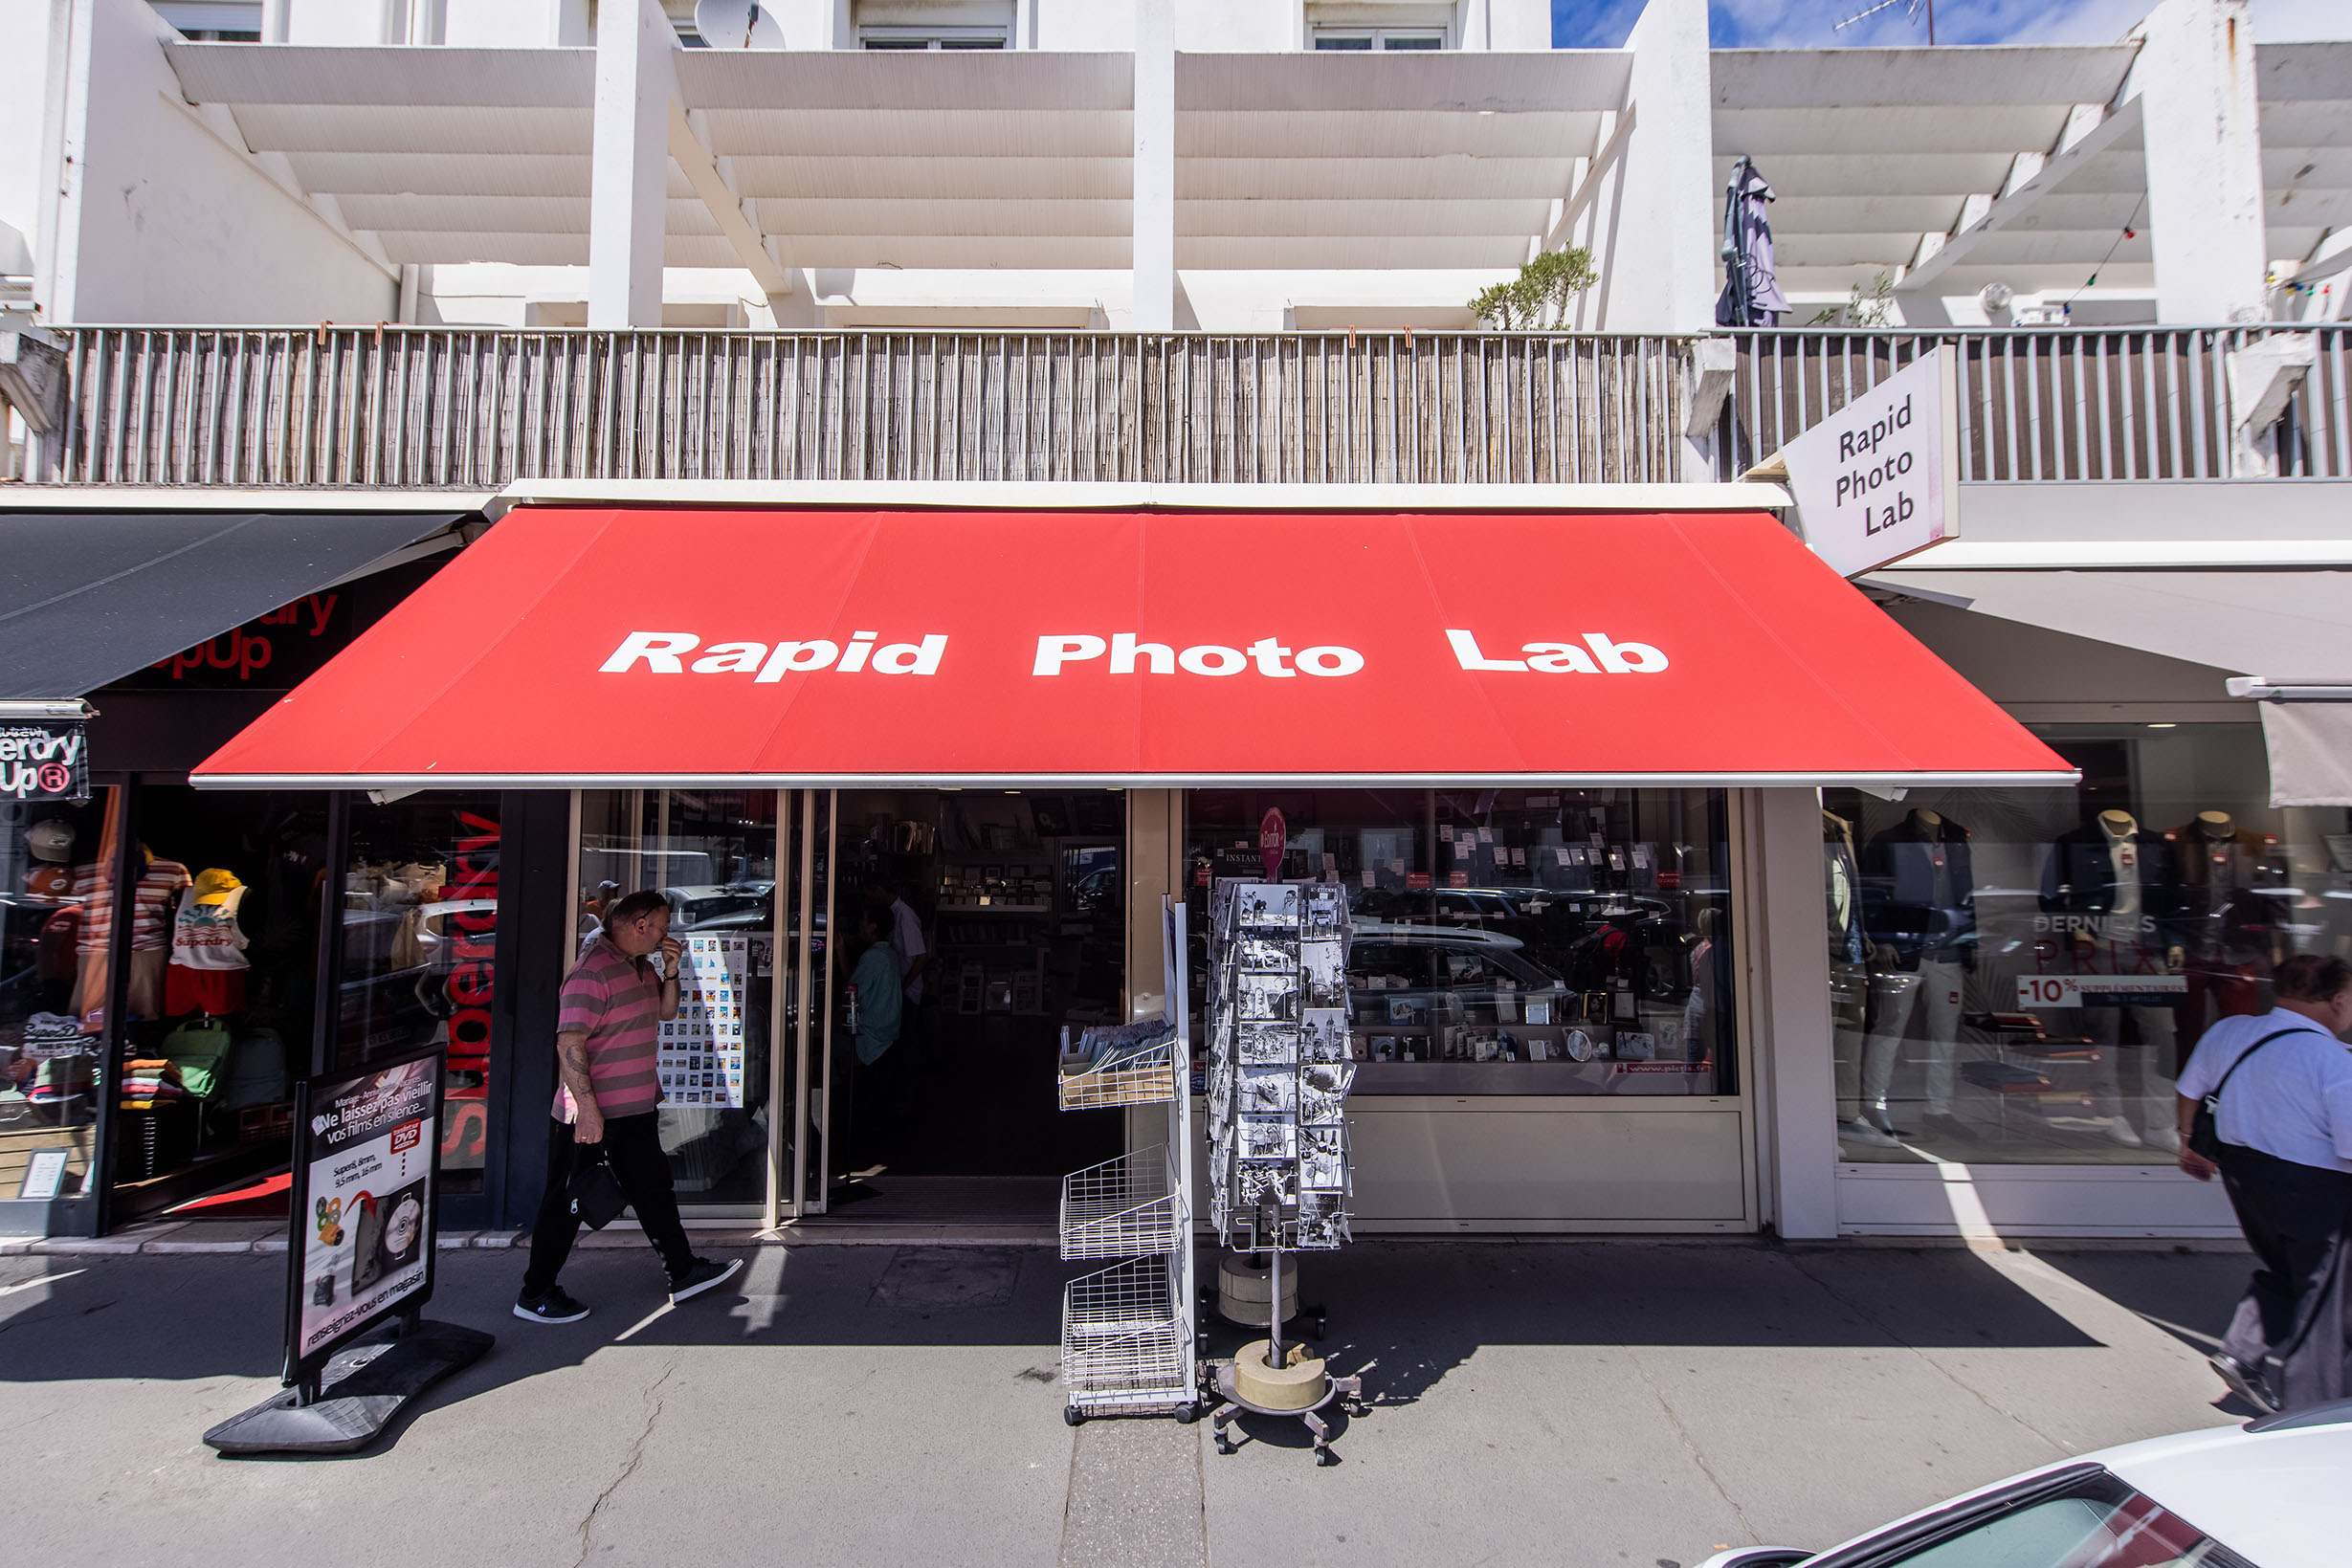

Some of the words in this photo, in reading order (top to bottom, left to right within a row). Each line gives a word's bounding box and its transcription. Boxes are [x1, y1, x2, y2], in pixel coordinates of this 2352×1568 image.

[1838, 392, 1912, 464] Rapid
[1835, 449, 1914, 508] Photo
[1865, 491, 1915, 538] Lab
[598, 629, 950, 685] Rapid
[1032, 633, 1366, 678] Photo
[1444, 628, 1671, 674] Lab
[175, 937, 233, 948] Superdry
[2035, 939, 2159, 976] PRIX
[341, 1099, 379, 1124] laissez
[379, 1094, 400, 1114] pas
[403, 1080, 433, 1102] vieillir
[327, 1128, 346, 1145] vos
[347, 1117, 373, 1137] films
[373, 1113, 387, 1128] en
[394, 1129, 418, 1145] DVD
[307, 1297, 377, 1348] renseignez-vous
[377, 1289, 389, 1304] en
[389, 1269, 424, 1297] magasin
